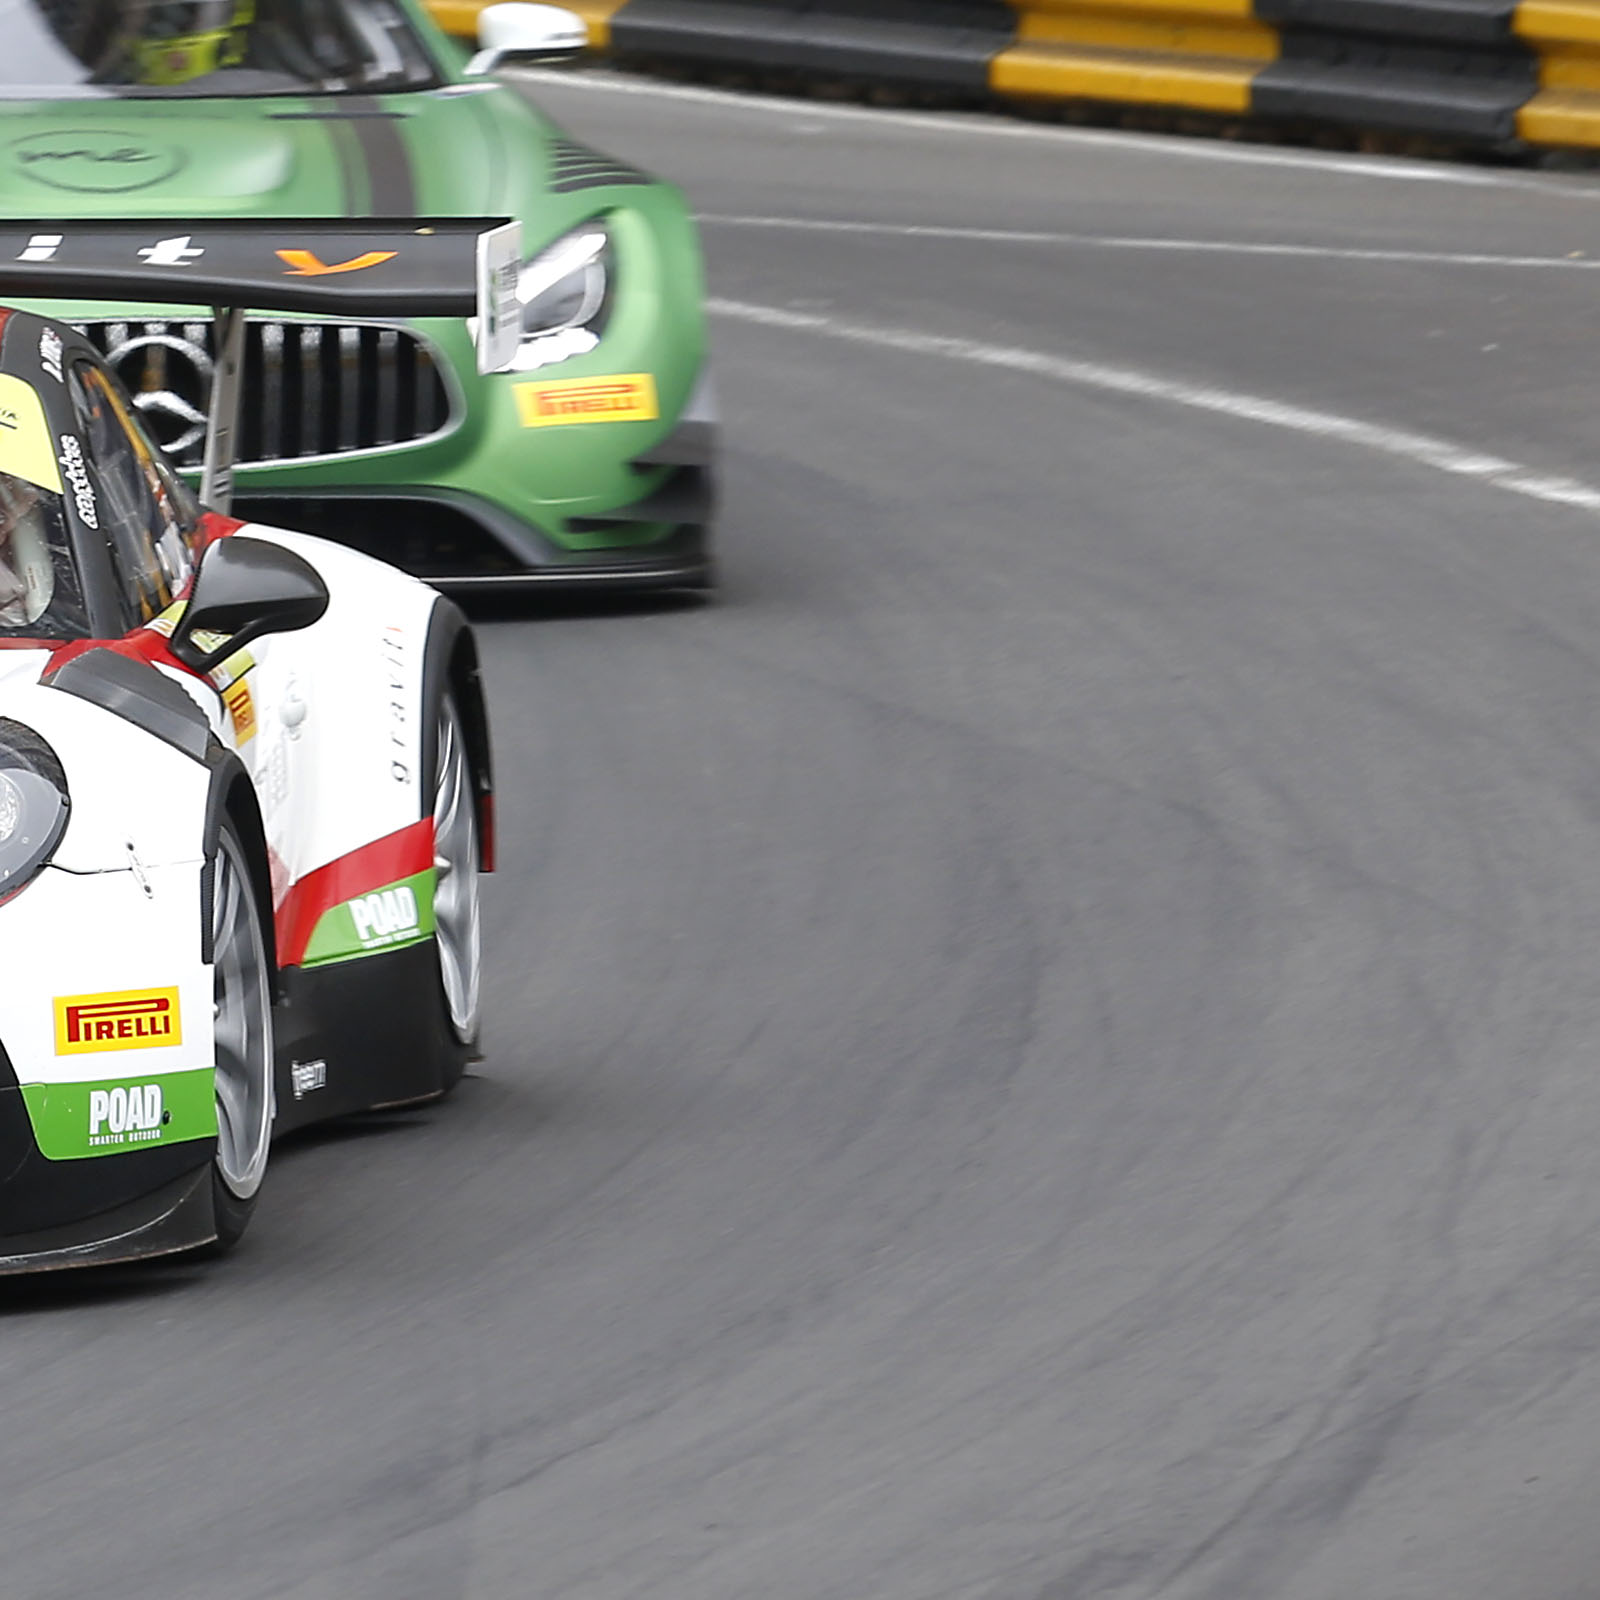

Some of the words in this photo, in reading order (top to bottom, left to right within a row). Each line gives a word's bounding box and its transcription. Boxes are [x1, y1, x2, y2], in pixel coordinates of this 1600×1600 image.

[348, 885, 419, 941] POAD
[66, 997, 171, 1043] PIRELLI
[89, 1084, 162, 1136] POAD
